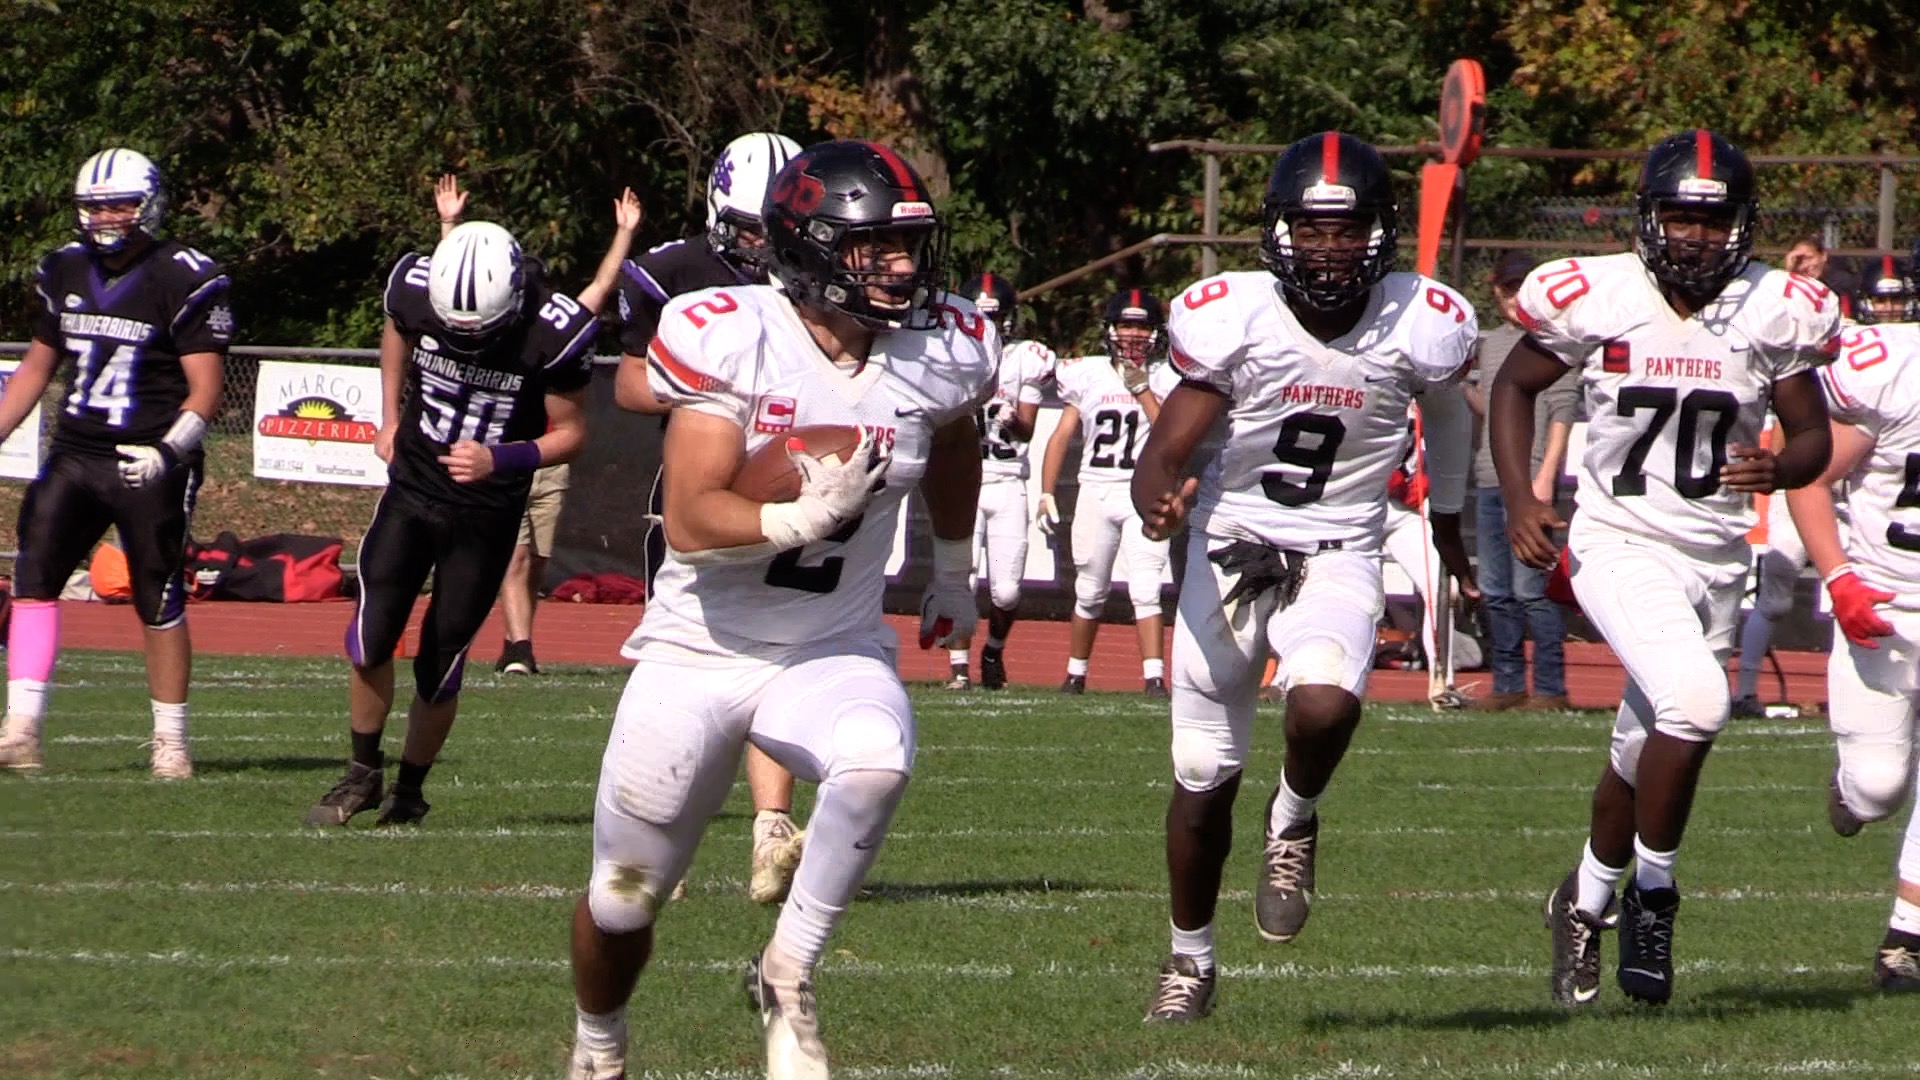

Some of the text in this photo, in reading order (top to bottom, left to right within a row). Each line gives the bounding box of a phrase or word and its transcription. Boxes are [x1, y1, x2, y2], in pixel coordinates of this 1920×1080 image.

[1184, 280, 1228, 310] 9
[1537, 259, 1590, 309] 70
[538, 292, 581, 330] 50
[681, 292, 739, 330] 2
[1427, 288, 1465, 323] 9
[60, 311, 154, 342] THUNDERBIRDS
[1840, 326, 1889, 371] 50
[65, 337, 137, 426] 74
[412, 346, 525, 392] THUNDERBIRDS
[1645, 357, 1722, 380] PANTHERS
[279, 373, 362, 407] MARCO
[1281, 385, 1365, 409] PANTHERS
[266, 419, 367, 440] PIZZERIA
[1091, 409, 1139, 470] 21
[1612, 386, 1740, 499] 70
[1260, 412, 1347, 508] 9
